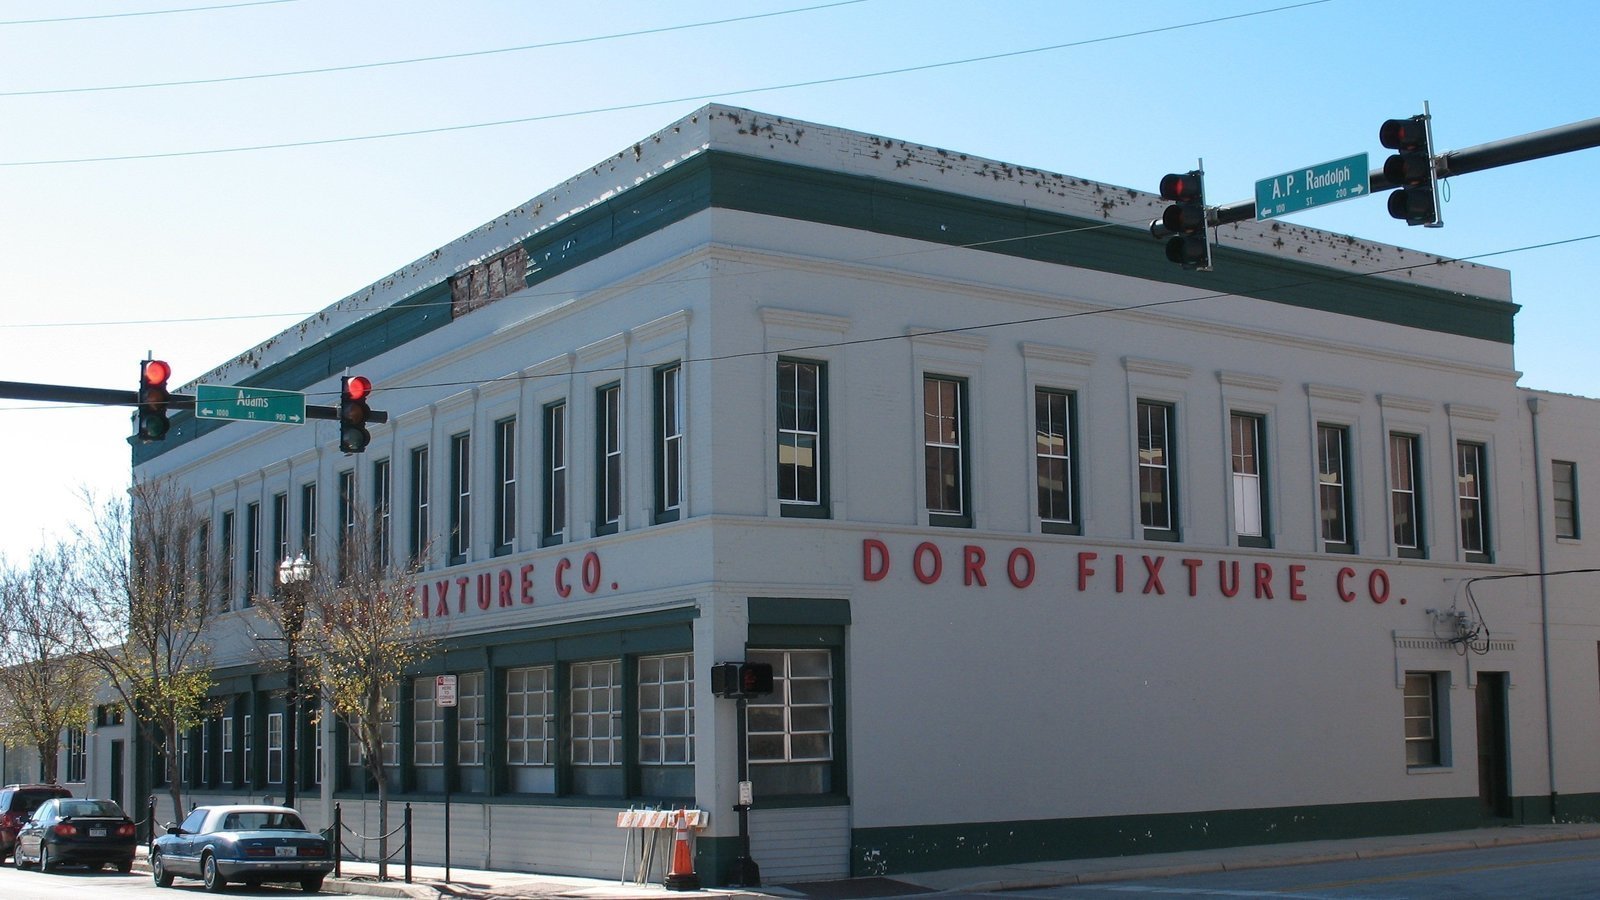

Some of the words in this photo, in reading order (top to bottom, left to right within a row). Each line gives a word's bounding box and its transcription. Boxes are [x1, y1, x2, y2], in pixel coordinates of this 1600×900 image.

[1272, 175, 1300, 200] A.P.
[1306, 165, 1350, 190] Randolph
[1335, 188, 1347, 199] 200
[1276, 203, 1286, 213] 100
[236, 389, 269, 408] Adams
[554, 551, 619, 598] CO.
[863, 538, 1036, 589] DORO
[1078, 551, 1308, 601] FIXTURE
[1336, 566, 1408, 605] CO.
